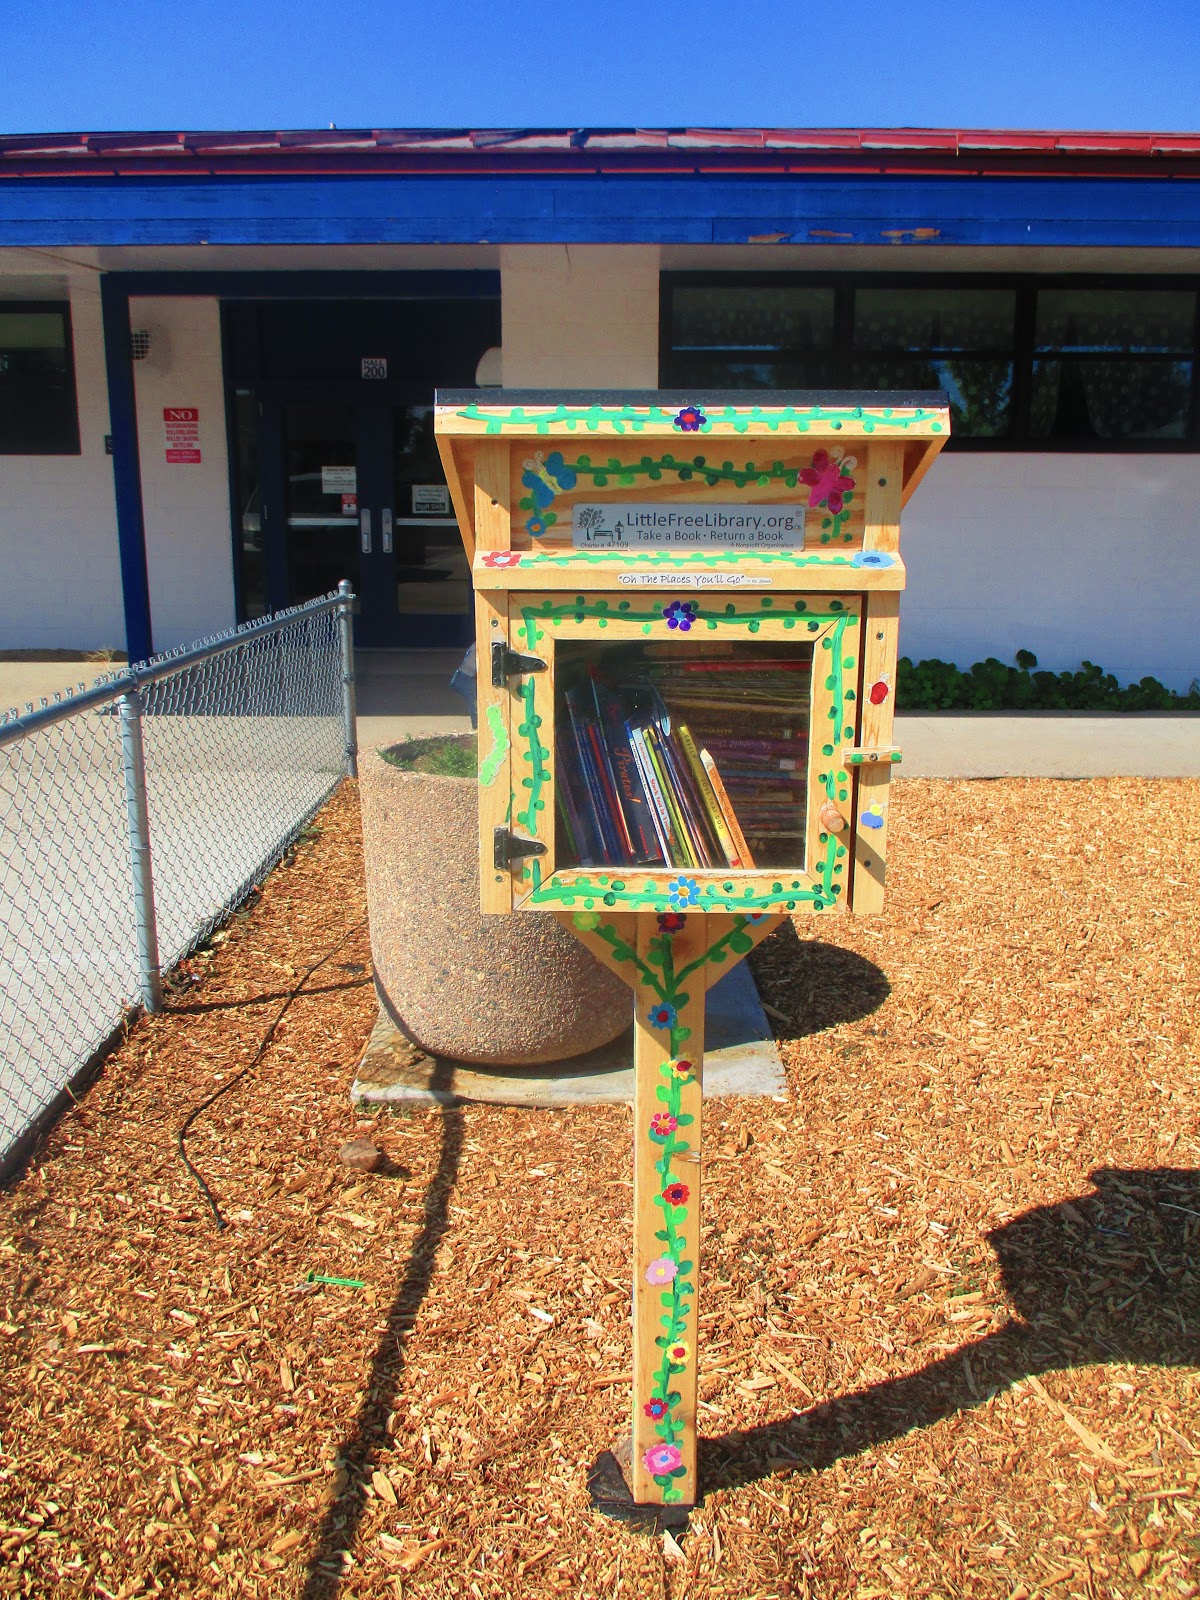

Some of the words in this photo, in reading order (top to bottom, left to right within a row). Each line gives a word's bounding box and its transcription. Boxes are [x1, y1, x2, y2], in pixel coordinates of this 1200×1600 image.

[363, 366, 385, 378] 200
[170, 410, 193, 420] NO
[431, 503, 445, 511] Only
[627, 512, 794, 531] LittleFreeLibrary.org
[637, 530, 662, 541] Take
[665, 533, 671, 541] a
[674, 530, 701, 541] Book
[710, 530, 746, 541] Return
[748, 533, 755, 541] a
[757, 530, 784, 541] Book
[640, 575, 658, 584] The
[660, 575, 691, 584] Places
[694, 575, 724, 587] You'll
[614, 747, 642, 804] Pirates!
